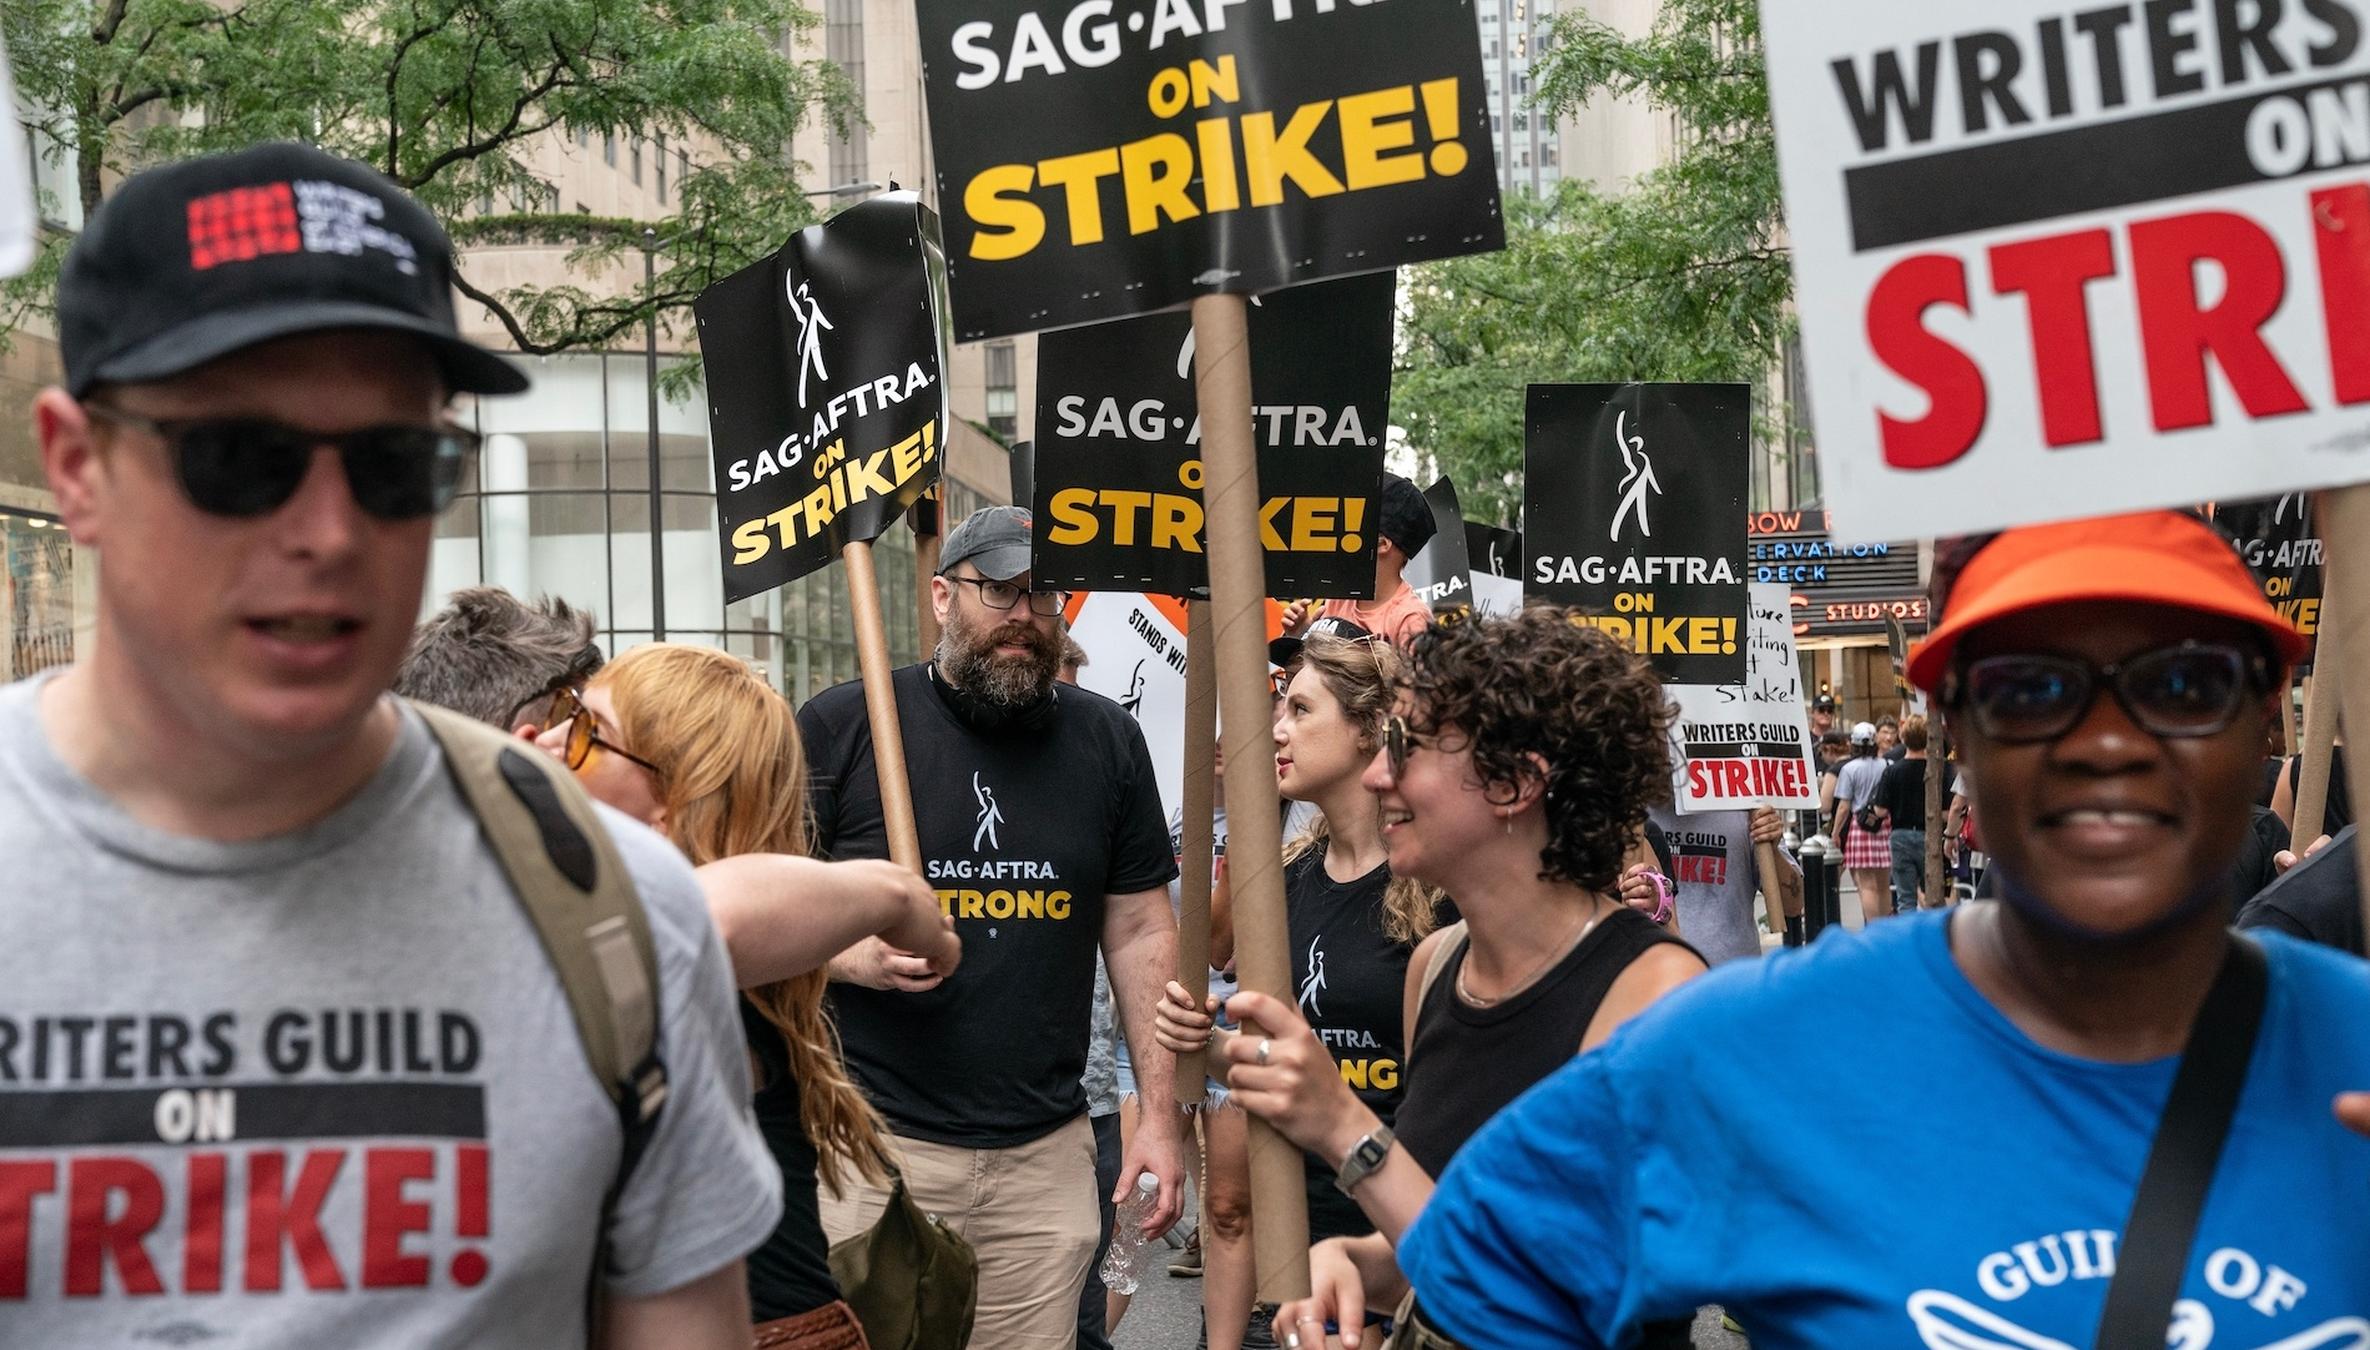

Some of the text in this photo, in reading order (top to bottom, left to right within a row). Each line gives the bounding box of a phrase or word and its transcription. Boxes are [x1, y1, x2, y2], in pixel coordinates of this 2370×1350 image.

[1147, 54, 1240, 119] ON
[1830, 0, 2361, 152] WRITERS
[2245, 82, 2370, 178] ON
[963, 77, 1469, 261] STRIKE!
[813, 438, 845, 480] ON
[731, 419, 935, 565] STRIKE!
[1047, 487, 1366, 553] STRKE!
[1757, 564, 1826, 584] DECK
[2264, 576, 2293, 598] ON
[1613, 592, 1654, 613] ON
[1826, 600, 1922, 622] STUDOS
[1128, 607, 1168, 655] STANDS
[1682, 723, 1800, 743] WRITERS GUILD
[1741, 744, 1759, 756] ON
[1689, 760, 1810, 798] STRIKE!
[1685, 832, 1727, 847] GUILD
[265, 1010, 482, 1074] GUILD
[154, 1089, 236, 1142] ON
[2205, 1247, 2307, 1317] OF
